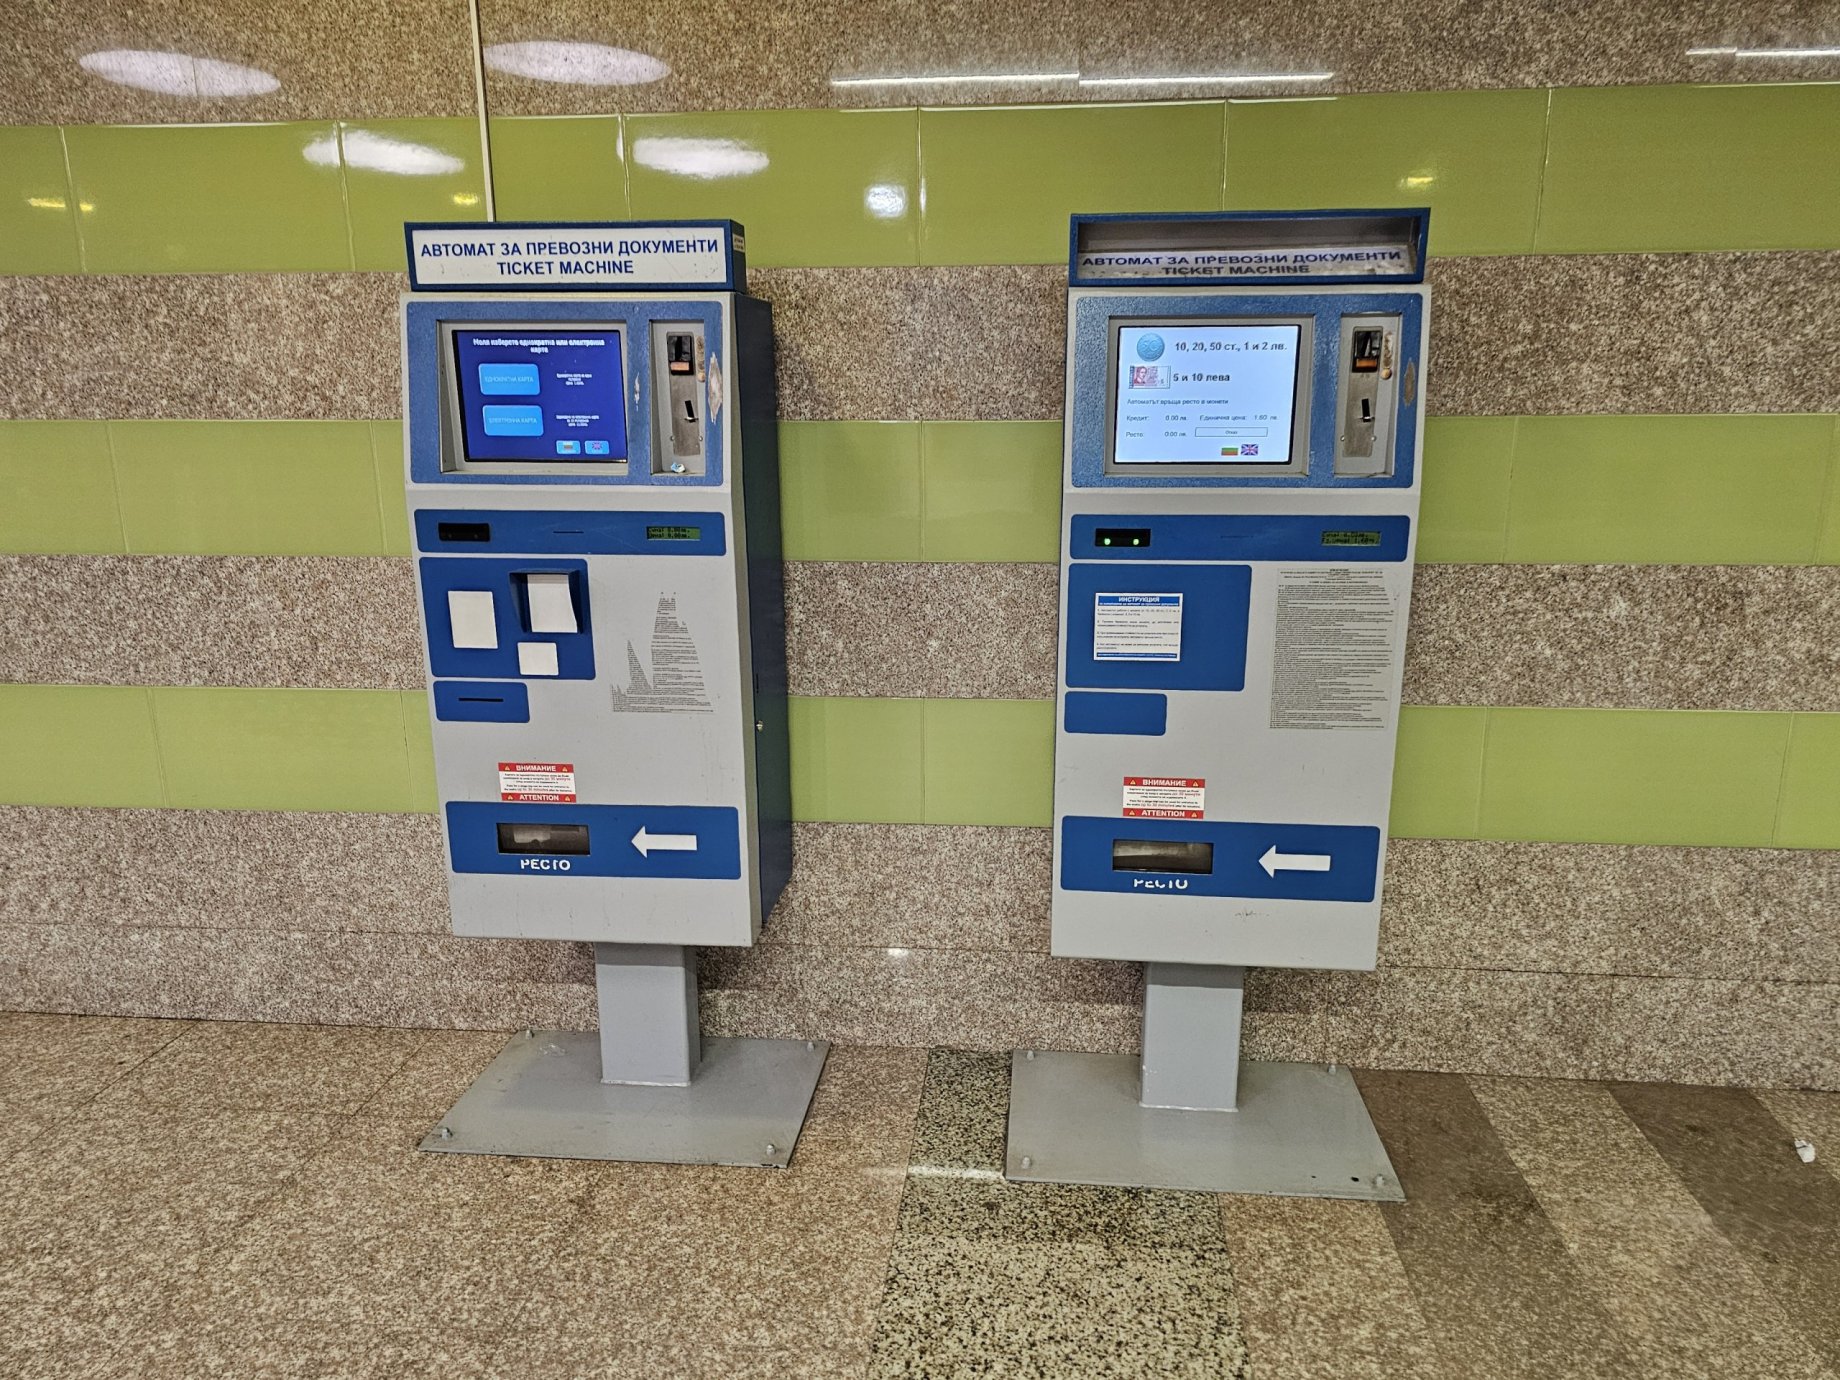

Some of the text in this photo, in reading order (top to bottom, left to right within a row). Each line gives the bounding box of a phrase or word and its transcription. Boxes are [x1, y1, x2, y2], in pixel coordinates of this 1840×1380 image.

[421, 243, 496, 257] АВТОМАТ
[501, 242, 522, 256] ЗА
[527, 241, 614, 256] ПРЕВОЗНИ
[618, 239, 719, 256] ДОКУМЕНТИ
[1082, 251, 1401, 266] АВТОМАТ ЗА ПРЕВОЗНИ ДОКУМЕНТИ
[497, 260, 634, 275] TICKET MACHINE
[1162, 264, 1311, 276] TICKET MACHINE
[1175, 341, 1190, 352] 10,
[1192, 341, 1207, 352] 20,
[1209, 341, 1222, 351] 50
[1244, 341, 1249, 351] 1
[1252, 343, 1259, 351] и
[1261, 341, 1268, 351] 2
[1270, 343, 1287, 351] лв.
[1173, 372, 1179, 382] 5
[1181, 374, 1189, 382] и
[1192, 372, 1203, 382] 10
[1205, 373, 1230, 382] лева
[515, 764, 557, 772] ВНИМАНИЕ
[1142, 778, 1187, 787] ВНИМАНИЕ
[1141, 809, 1186, 817] ATTENTION
